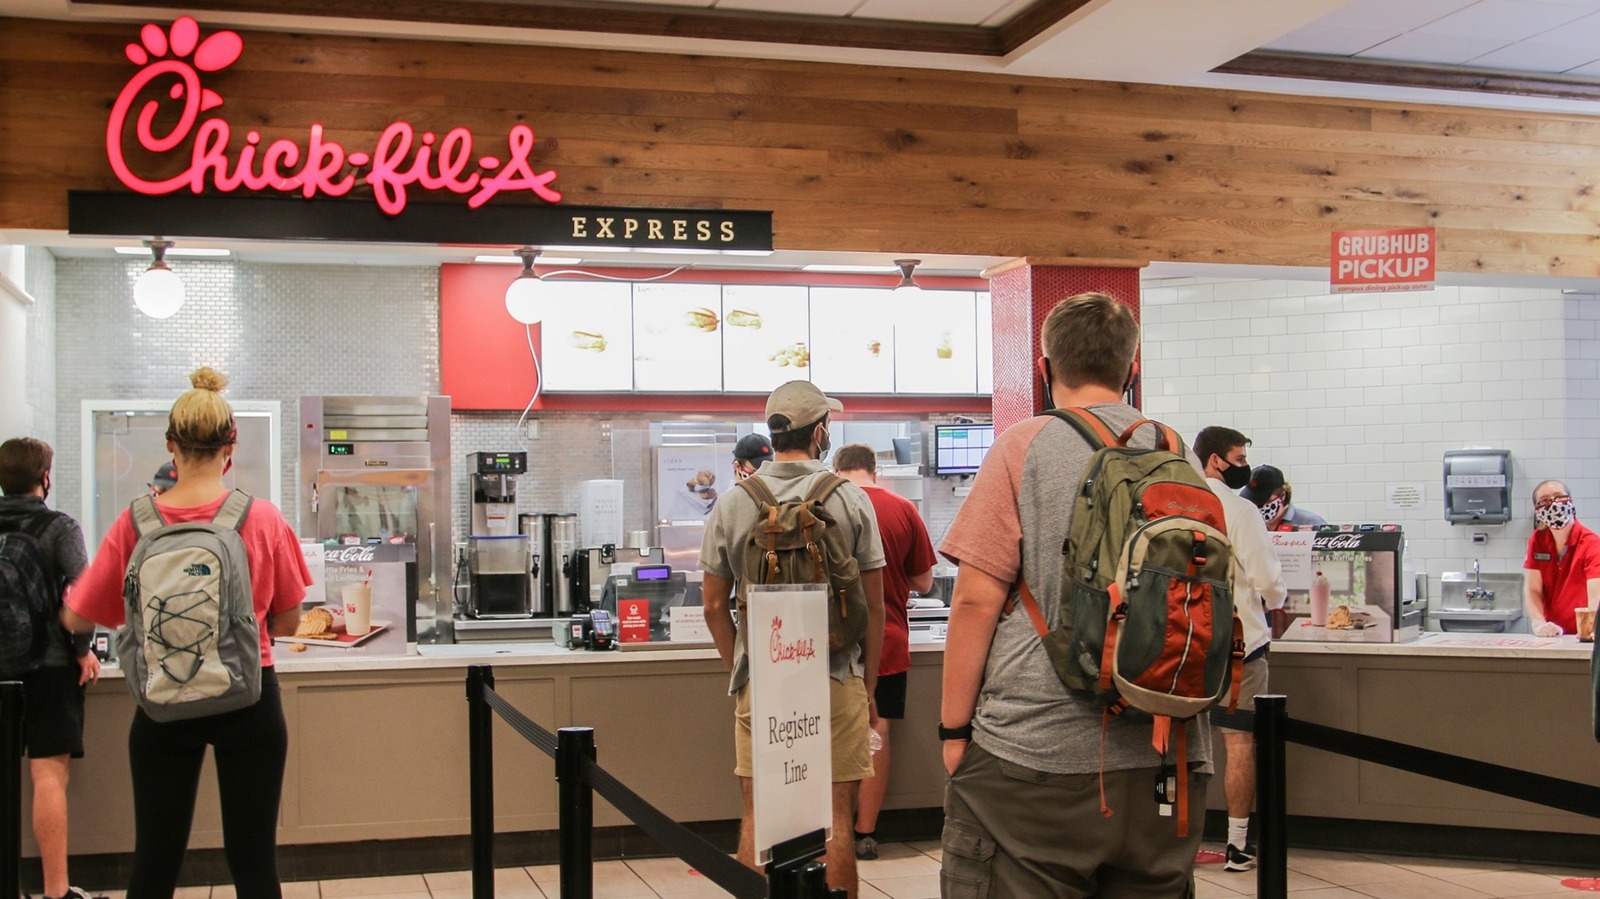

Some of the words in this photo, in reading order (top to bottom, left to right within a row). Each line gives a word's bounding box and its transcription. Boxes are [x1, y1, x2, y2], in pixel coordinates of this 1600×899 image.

[106, 58, 562, 215] Chick-fil-A
[572, 216, 735, 242] EXPRESS
[1338, 233, 1430, 256] GRUBHUB
[1338, 257, 1430, 279] PICKUP
[1365, 284, 1386, 292] dining
[1387, 283, 1410, 291] pickup
[1313, 533, 1364, 549] ca-Cola
[324, 546, 376, 563] ca-Cola
[340, 565, 358, 573] Fries
[768, 711, 821, 748] Register
[784, 759, 808, 785] Line
